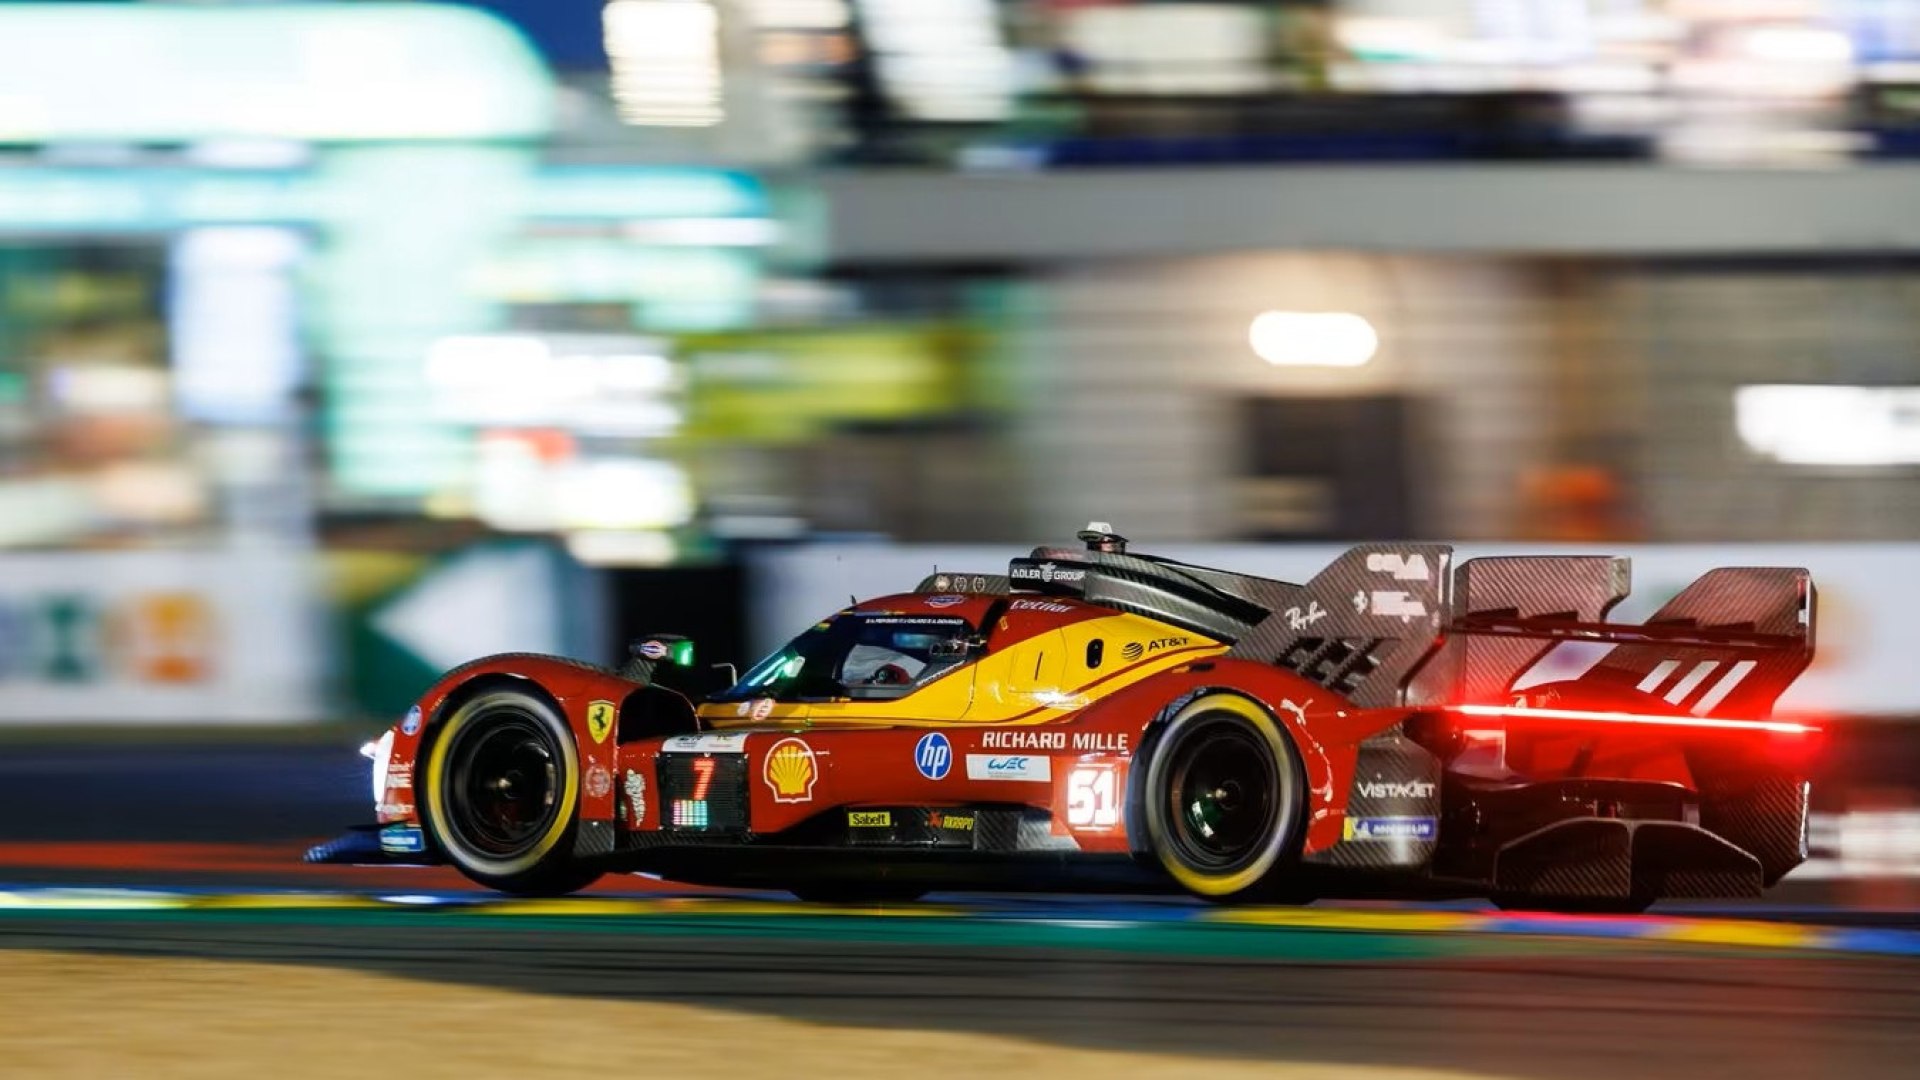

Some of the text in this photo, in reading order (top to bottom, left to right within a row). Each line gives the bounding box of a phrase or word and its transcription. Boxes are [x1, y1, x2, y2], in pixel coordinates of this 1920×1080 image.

[1011, 568, 1085, 581] ADLER GROUP
[1148, 636, 1189, 652] AT&T
[982, 731, 1129, 750] RICHARD MILLE
[921, 733, 948, 779] hp
[988, 756, 1029, 770] WEC
[693, 757, 716, 801] 7
[1067, 769, 1117, 827] 51
[852, 813, 887, 826] Sabelt
